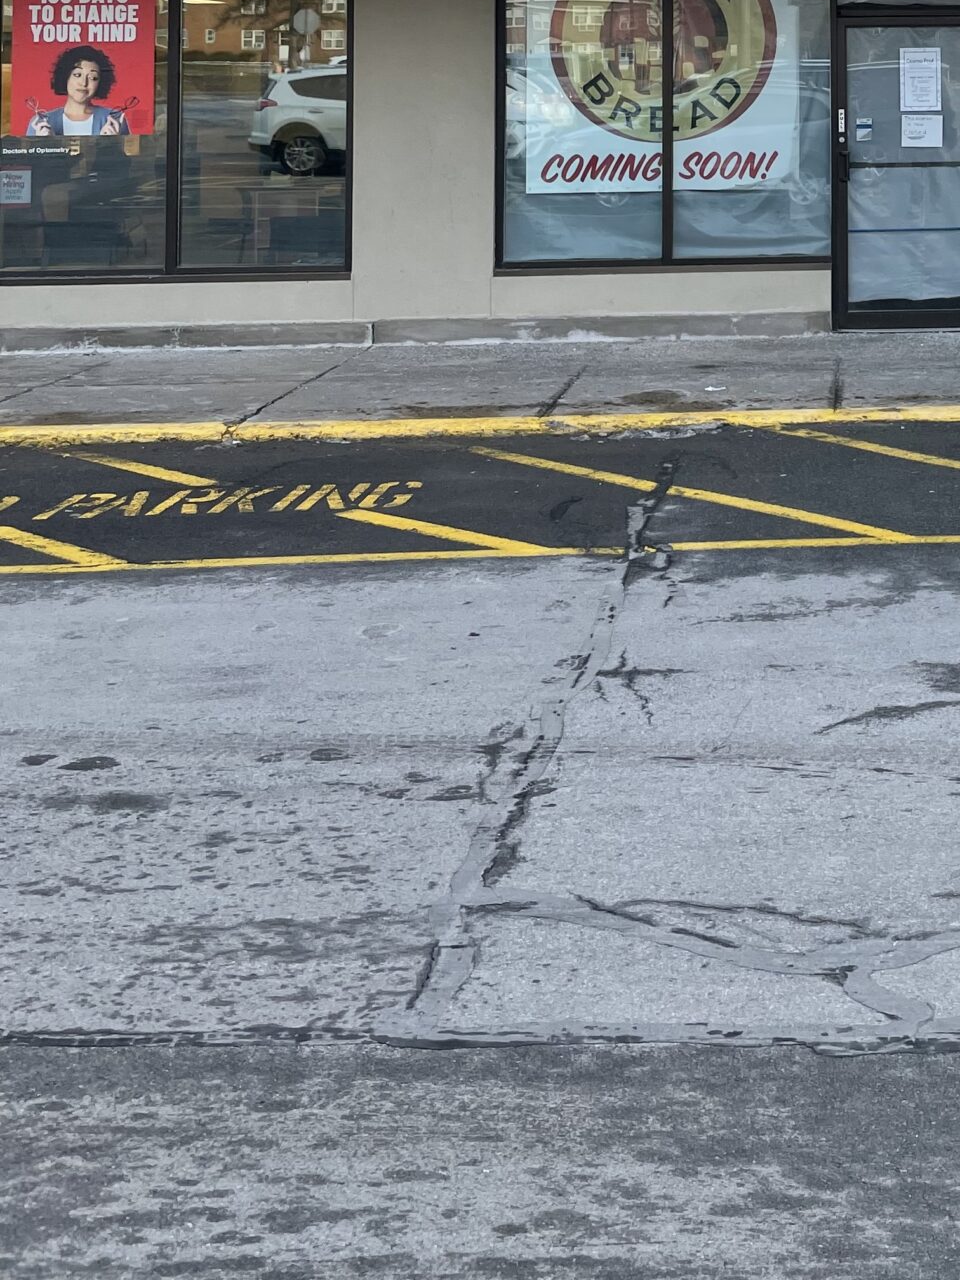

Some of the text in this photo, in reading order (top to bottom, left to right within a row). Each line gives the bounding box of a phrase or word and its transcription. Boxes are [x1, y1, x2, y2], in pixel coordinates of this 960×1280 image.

[28, 4, 139, 23] TO CHANGE
[30, 24, 137, 43] YOUR MIND
[582, 71, 741, 133] BREAD
[540, 150, 779, 184] COMING SOON!
[32, 480, 423, 521] PARKING
